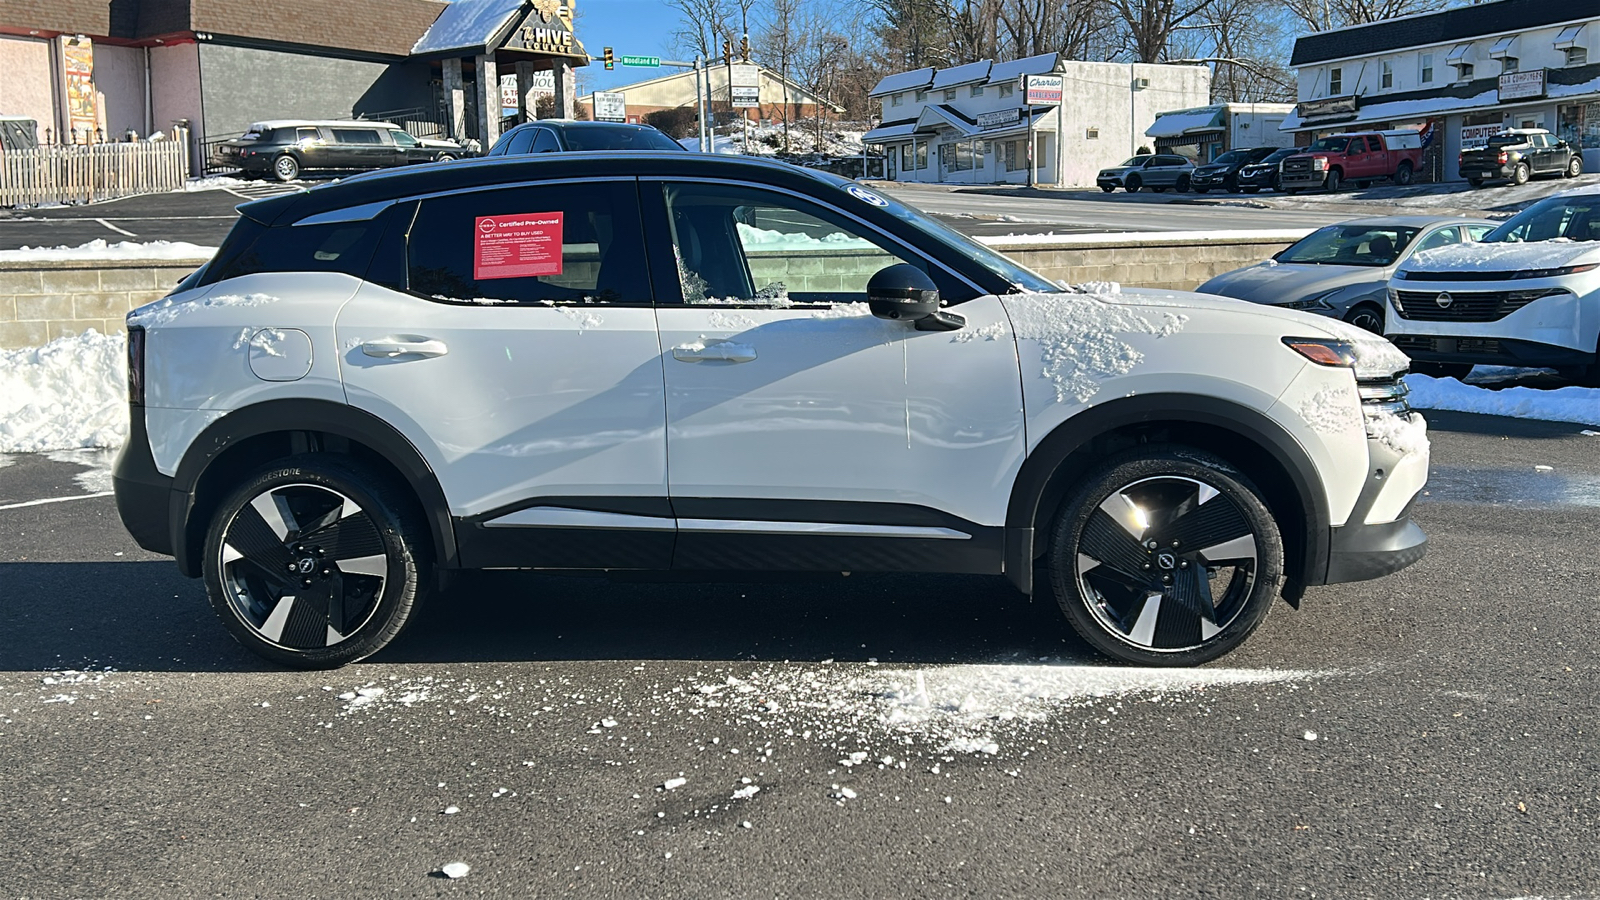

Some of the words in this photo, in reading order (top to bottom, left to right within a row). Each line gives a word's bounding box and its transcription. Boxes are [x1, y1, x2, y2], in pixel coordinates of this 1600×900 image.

[523, 26, 535, 40] The
[535, 28, 572, 46] HIVE
[525, 42, 573, 53] LOUNGE
[1029, 78, 1061, 87] Charles
[499, 220, 524, 228] Certified
[525, 218, 559, 226] Pre-Owned
